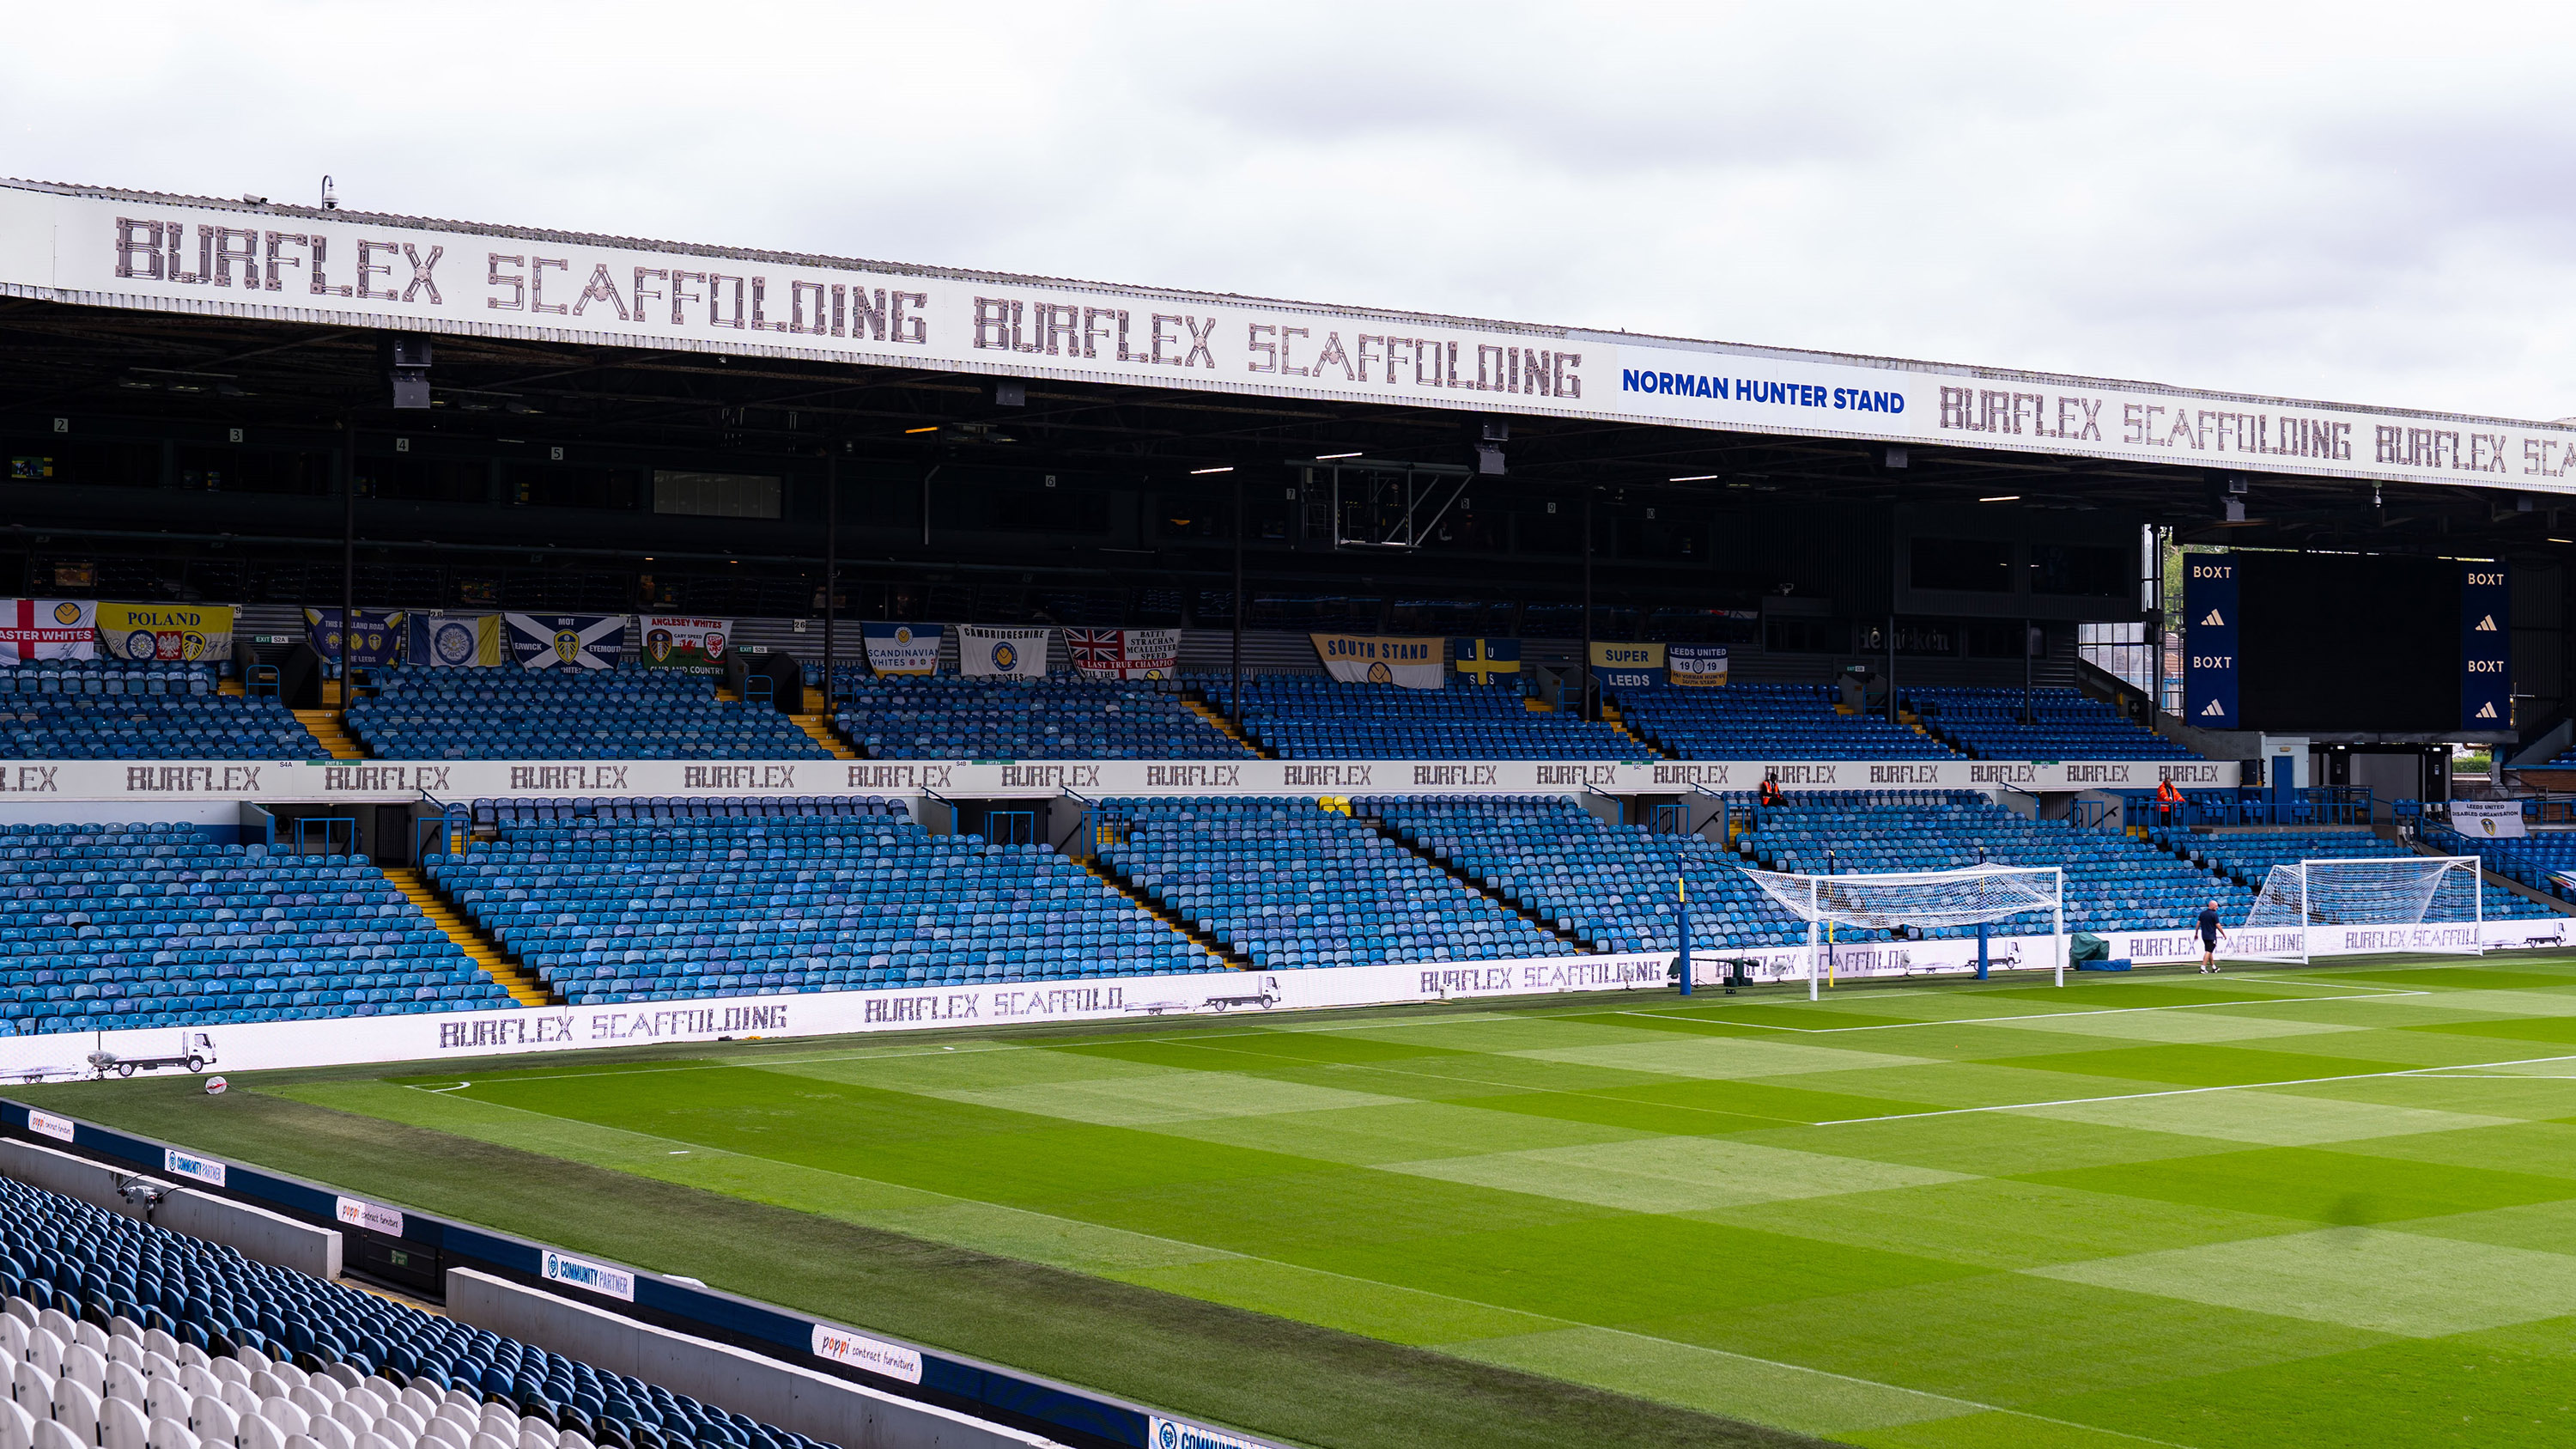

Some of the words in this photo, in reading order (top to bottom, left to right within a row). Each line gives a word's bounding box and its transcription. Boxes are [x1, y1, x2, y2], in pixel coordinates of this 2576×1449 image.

[115, 216, 443, 306] BURFLEX
[488, 253, 927, 344] SCAFFOLDING
[974, 295, 1216, 369] BURFLEX
[1249, 322, 1582, 399] SCAFFOLDING
[1623, 368, 1728, 400] NORMAN
[1735, 379, 1828, 408] HUNTER
[1833, 387, 1905, 414] STAND
[1940, 385, 2102, 442] BURFLEX
[2123, 403, 2352, 460] SCAFFOLDING
[2376, 423, 2506, 473] BURFLEX
[2524, 438, 2576, 478] SCA
[2194, 566, 2233, 579] BOXT
[2468, 574, 2505, 586] BOXT
[128, 611, 201, 626] POLAND
[558, 618, 574, 626] MOT
[652, 618, 690, 626] ANGLESEY
[692, 619, 722, 629] WHITES
[46, 630, 92, 641] WHITES
[963, 628, 1045, 639] CAMBRIDGESHIRE
[1131, 637, 1175, 646] STRACHAN
[514, 642, 543, 651] ERWICK
[1127, 644, 1176, 654] MCALLISTER
[1327, 639, 1375, 658] SOUTH
[1382, 643, 1428, 660] STAND
[1468, 647, 1473, 658] L
[1488, 647, 1494, 658] U
[1606, 649, 1649, 662] SUPER
[1670, 647, 1694, 656] LEEDS
[690, 666, 725, 675] COUNTRY
[1680, 661, 1690, 670] 19
[2194, 656, 2233, 669] BOXT
[2468, 661, 2505, 673] BOXT
[1489, 674, 1495, 685] S
[1608, 673, 1650, 686] LEEDS
[127, 766, 261, 792] BURFLEX
[325, 766, 450, 791] BURFLEX
[510, 765, 628, 789] BURFLEX
[684, 765, 795, 788] BURFLEX
[848, 765, 951, 788] BURFLEX
[1001, 765, 1101, 787] BURFLEX
[1147, 765, 1239, 786] BURFLEX
[1284, 765, 1372, 786] BURFLEX
[1414, 765, 1497, 785] BURFLEX
[1536, 765, 1616, 785] BURFLEX
[1653, 765, 1728, 784] BURFLEX
[1765, 765, 1837, 783] BURFLEX
[1870, 765, 1938, 783] BURFLEX
[1971, 764, 2036, 782] BURFLEX
[2067, 764, 2129, 782] BURFLEX
[2159, 764, 2218, 782] BURFLEX
[2129, 937, 2196, 957] BURFLEX
[2345, 930, 2406, 949] BURFLEX
[865, 993, 980, 1023] BURFLEX
[994, 987, 1122, 1016] SCAFFOLD
[440, 1015, 574, 1049] BURFLEX
[592, 1004, 787, 1040] SCAFFOLDING
[342, 1204, 360, 1221] poppi
[561, 1260, 598, 1287] COMMUNITY
[598, 1271, 628, 1295] PARTNER
[822, 1336, 851, 1359] poppi
[852, 1346, 880, 1363] contract
[883, 1350, 914, 1372] furniture
